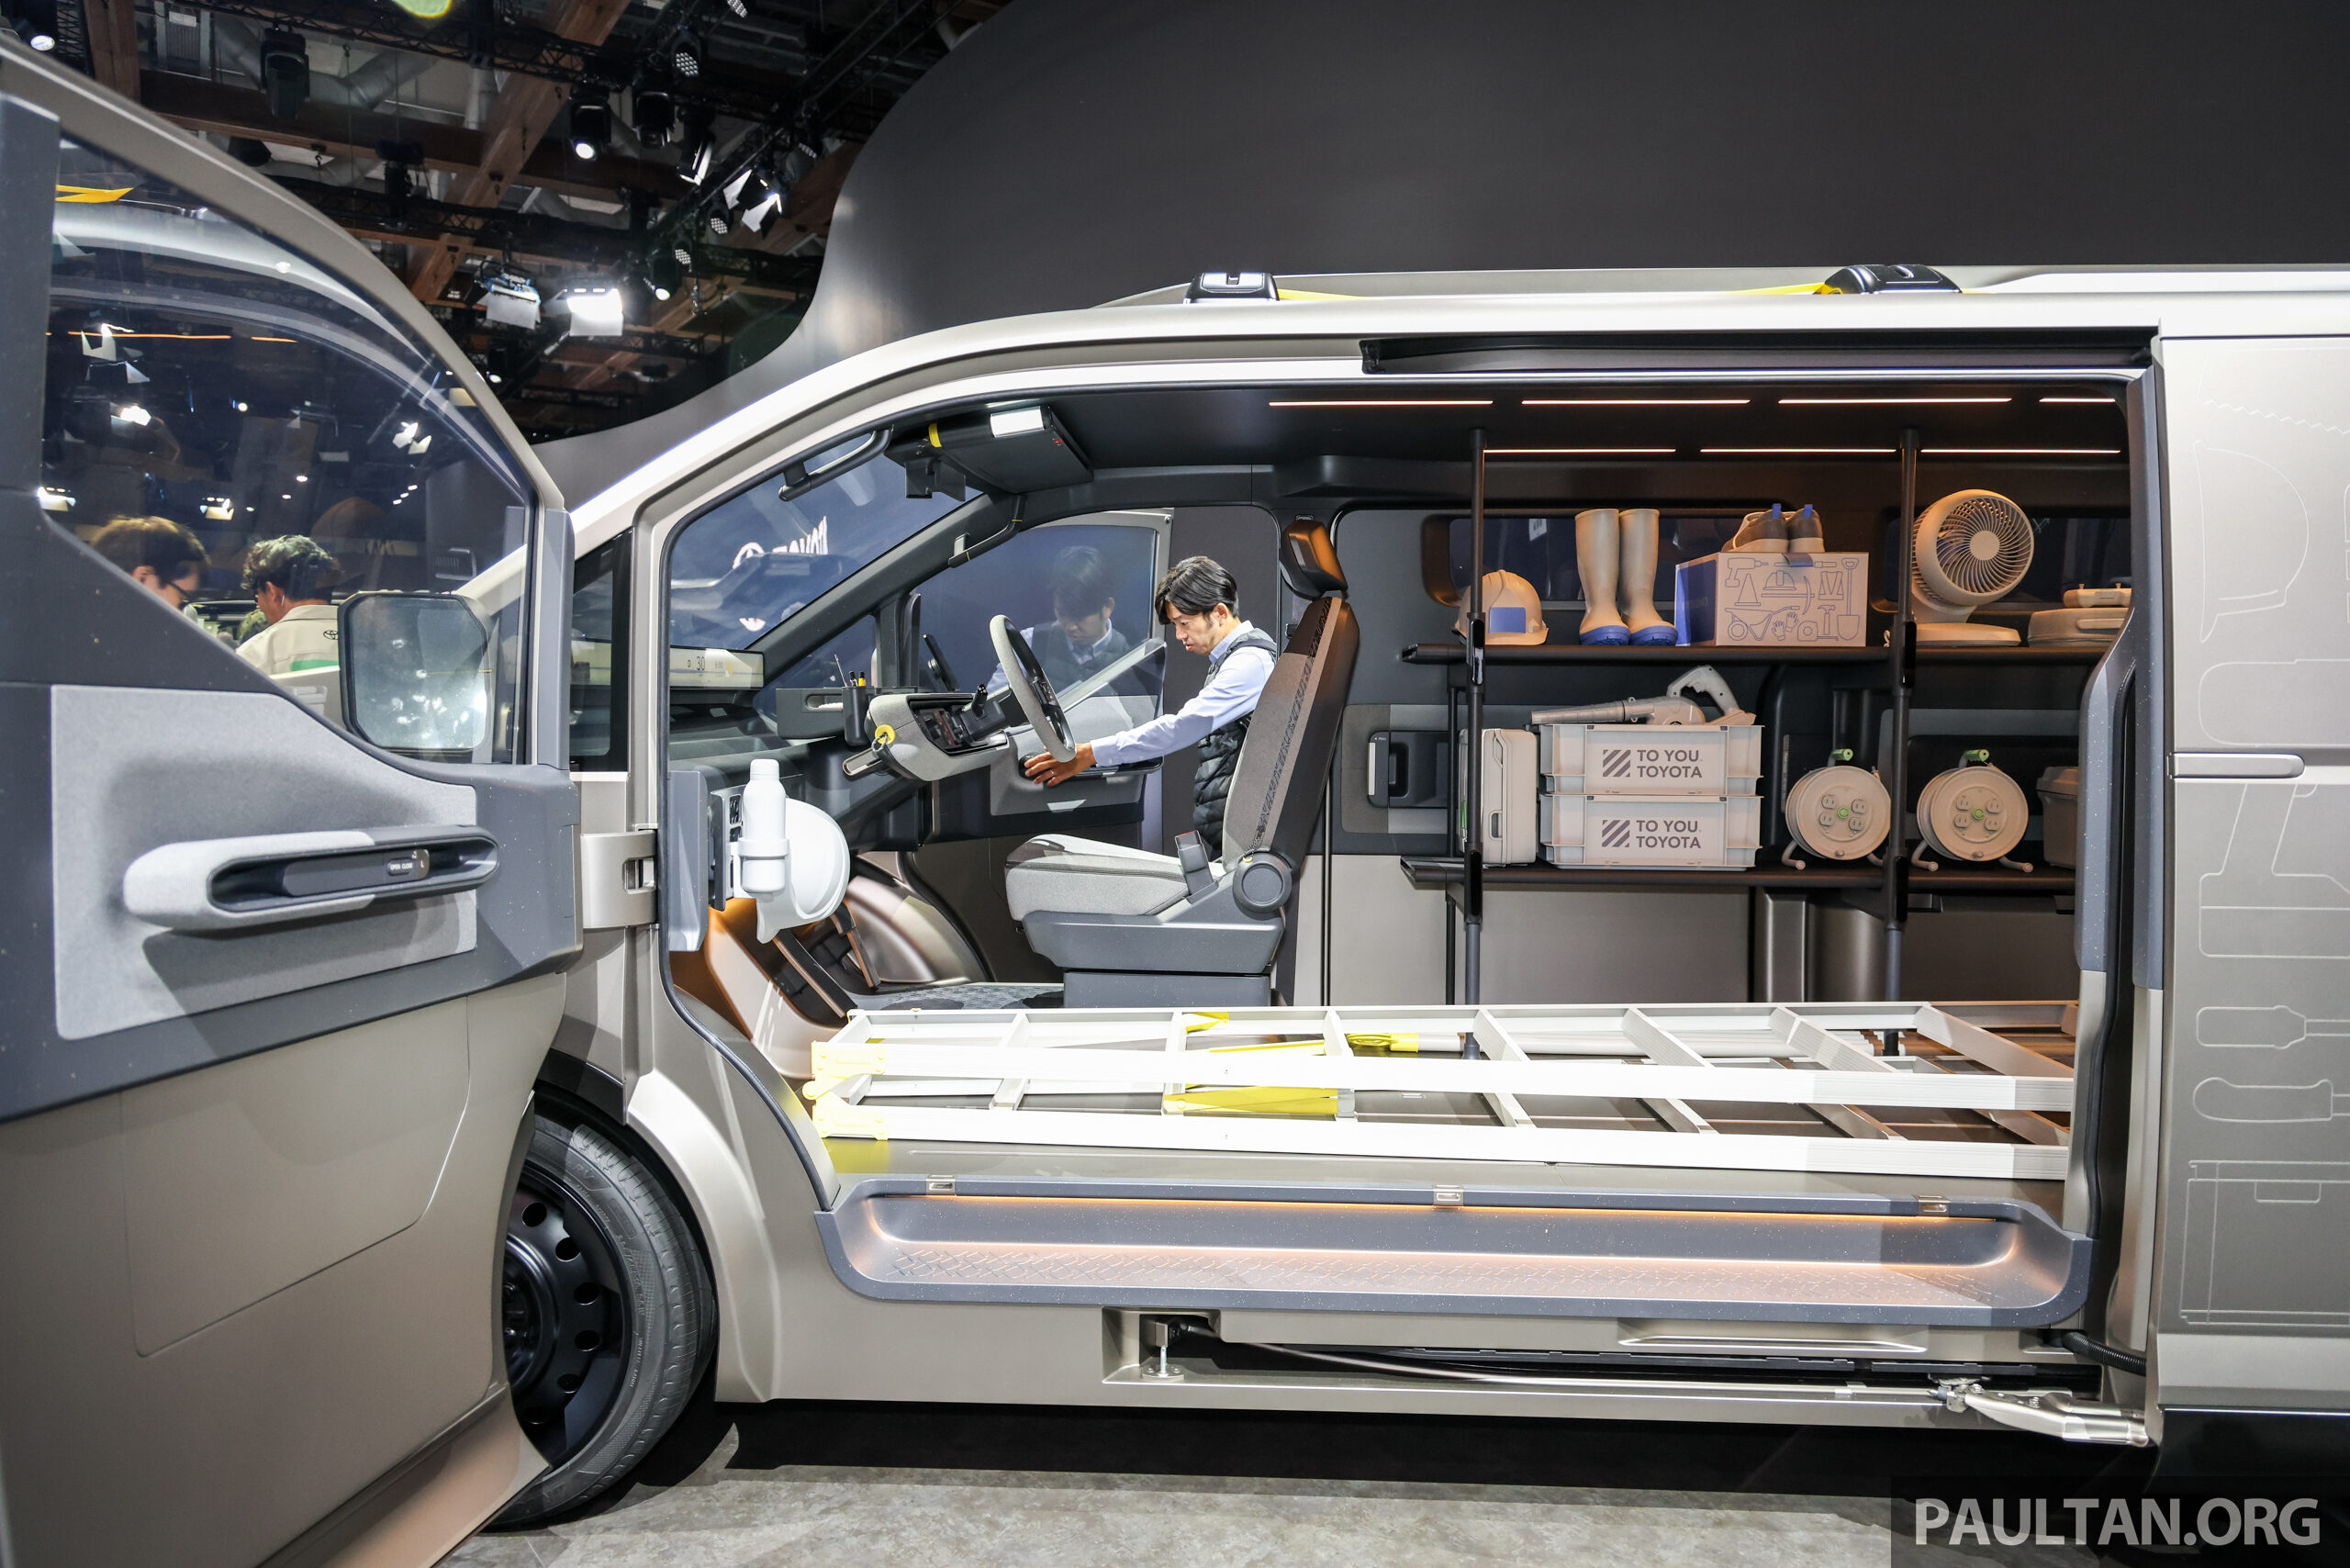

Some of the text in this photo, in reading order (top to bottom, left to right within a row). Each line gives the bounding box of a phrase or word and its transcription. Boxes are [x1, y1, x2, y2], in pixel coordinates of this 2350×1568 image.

[1637, 749, 1699, 762] TO YOU
[1637, 766, 1703, 778] TOYOTA
[1636, 820, 1698, 833] TO YOU
[1636, 835, 1702, 849] TOYOTA
[389, 863, 401, 871] OPEN
